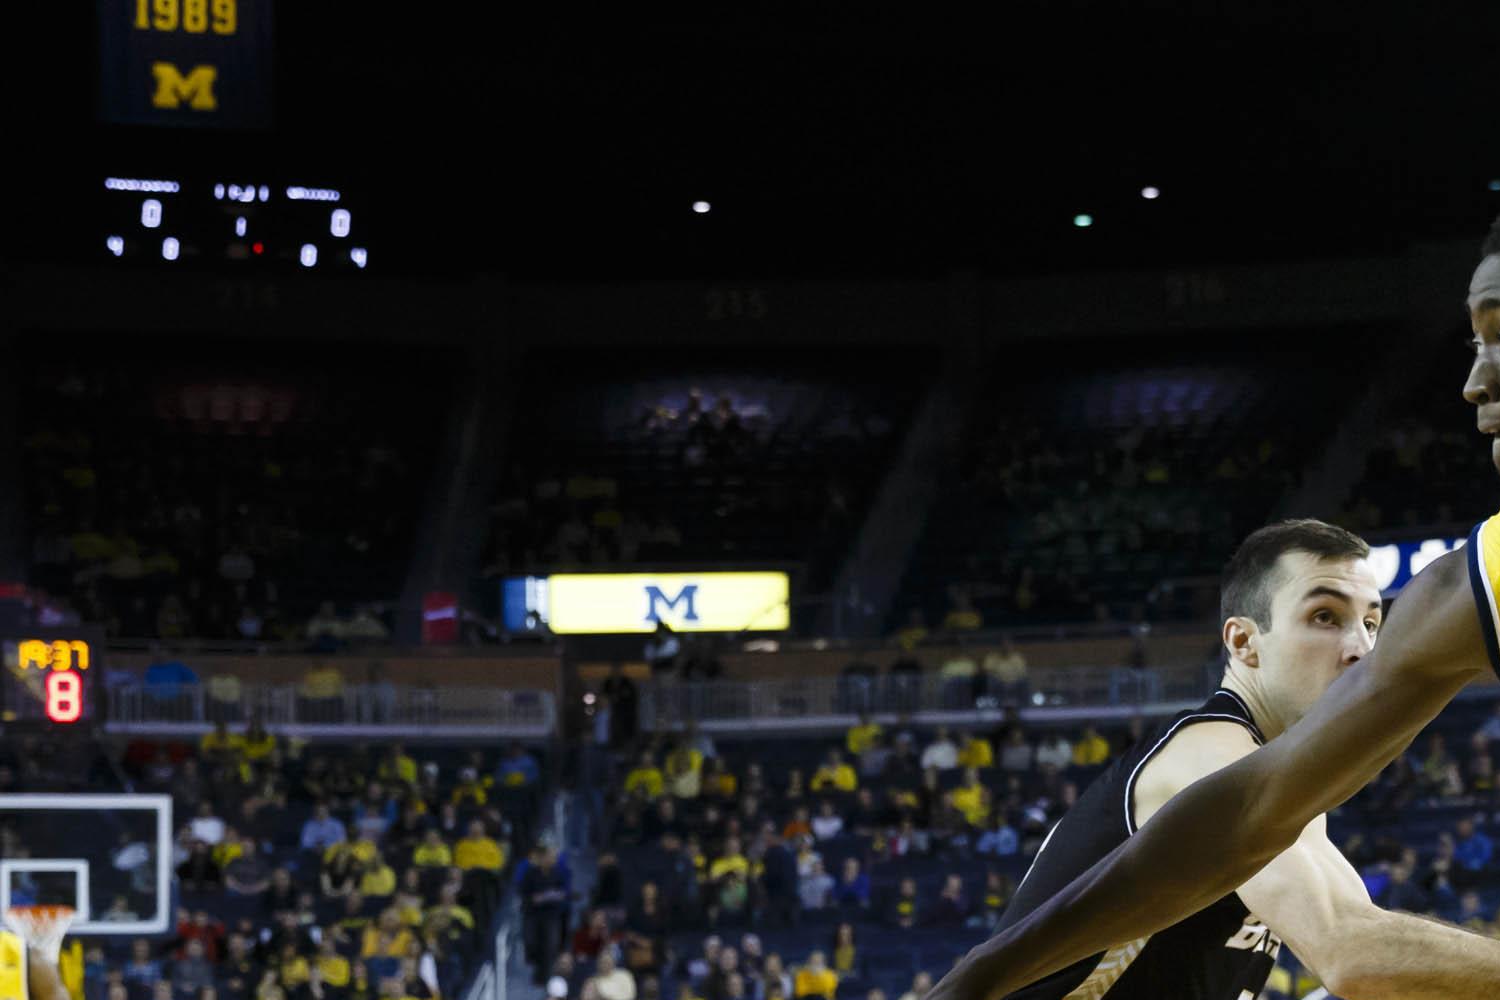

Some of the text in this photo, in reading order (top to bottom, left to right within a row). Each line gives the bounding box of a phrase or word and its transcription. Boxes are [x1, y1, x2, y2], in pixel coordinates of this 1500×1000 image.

[135, 0, 237, 34] 1989
[152, 61, 217, 109] M
[644, 585, 699, 620] M
[45, 669, 83, 723] 8
